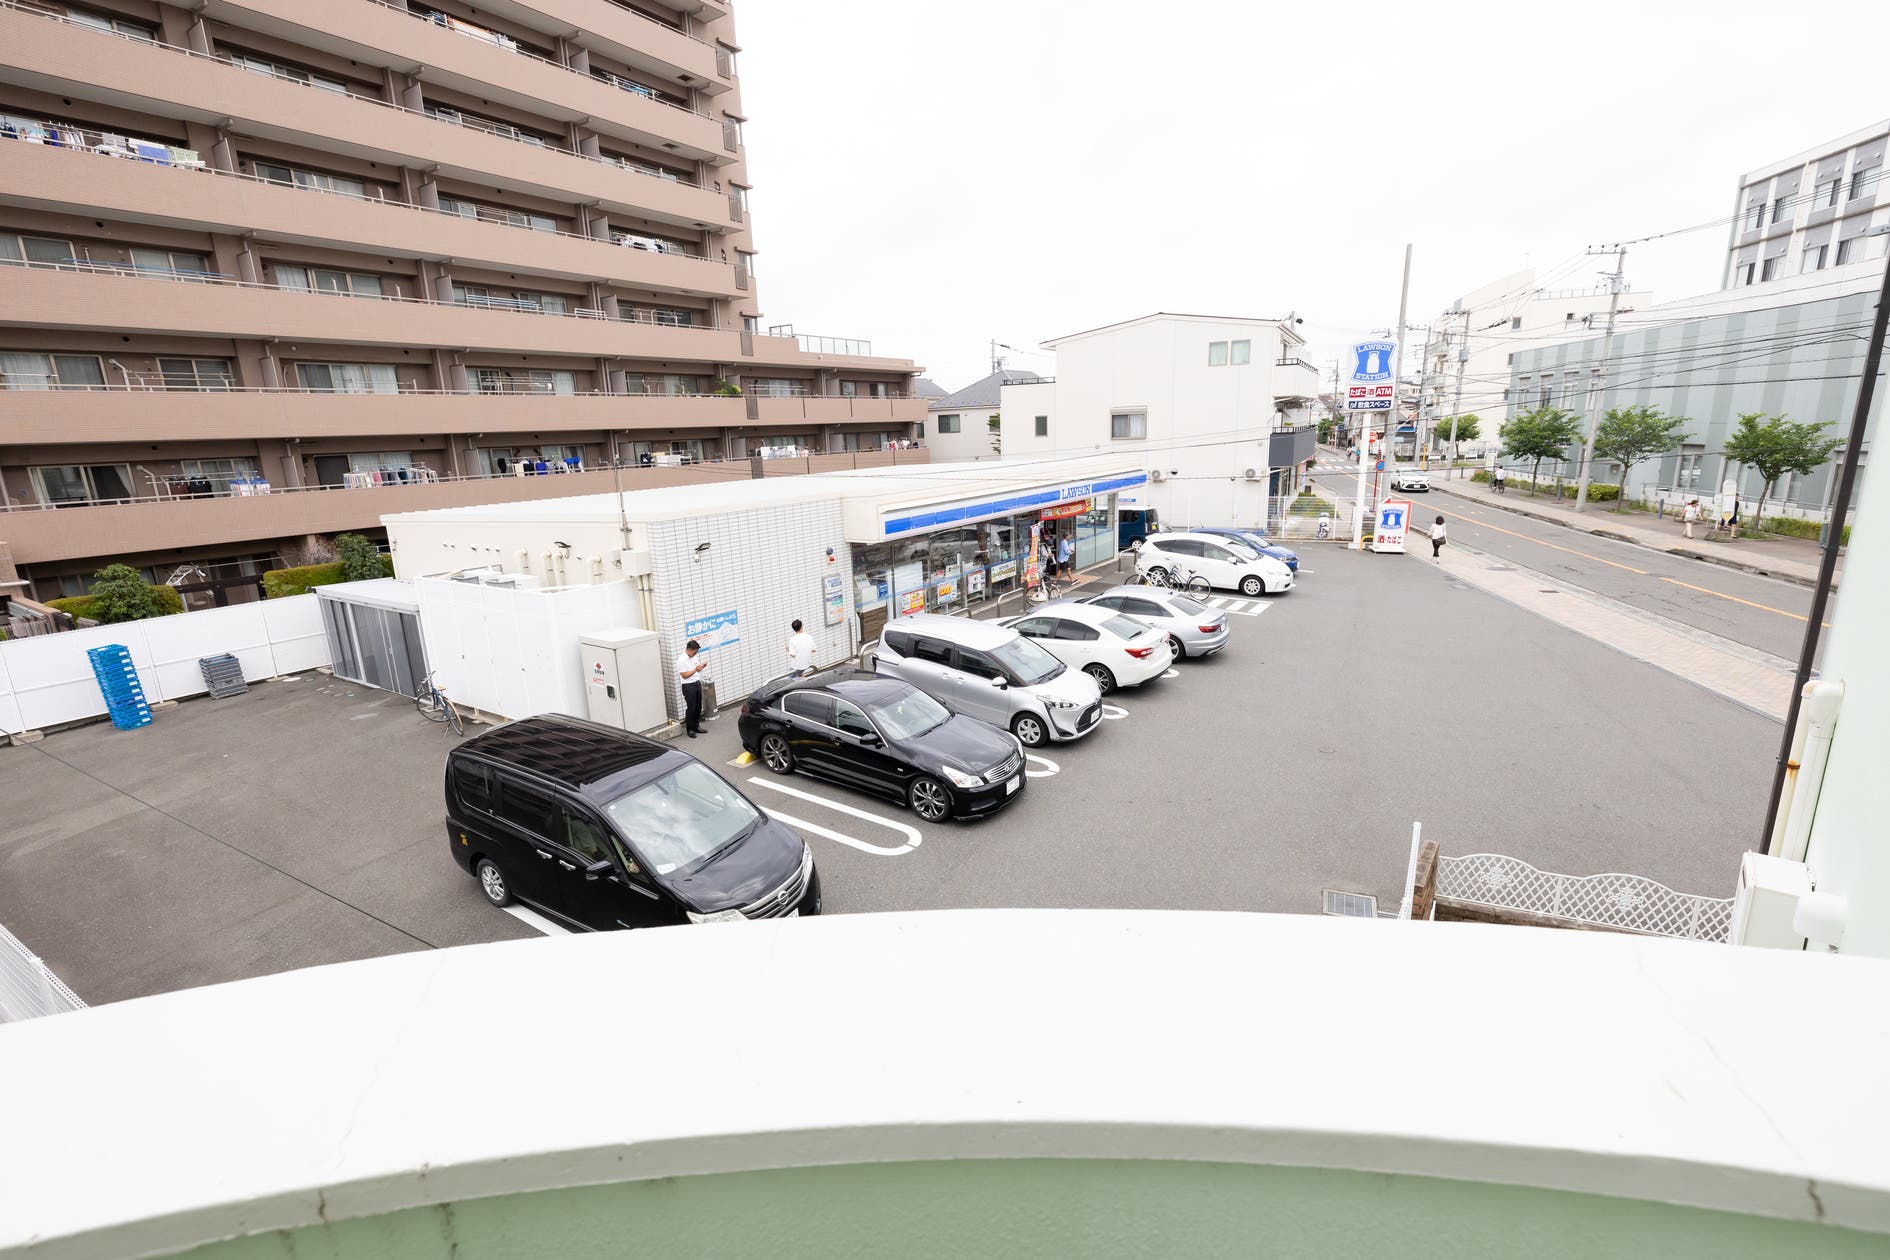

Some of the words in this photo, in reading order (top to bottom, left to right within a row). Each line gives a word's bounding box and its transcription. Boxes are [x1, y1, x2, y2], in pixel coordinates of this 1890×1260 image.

[1358, 344, 1392, 352] LAWSON
[1355, 372, 1389, 380] STATION
[1376, 387, 1392, 395] ATM
[1062, 485, 1091, 499] LAWSON
